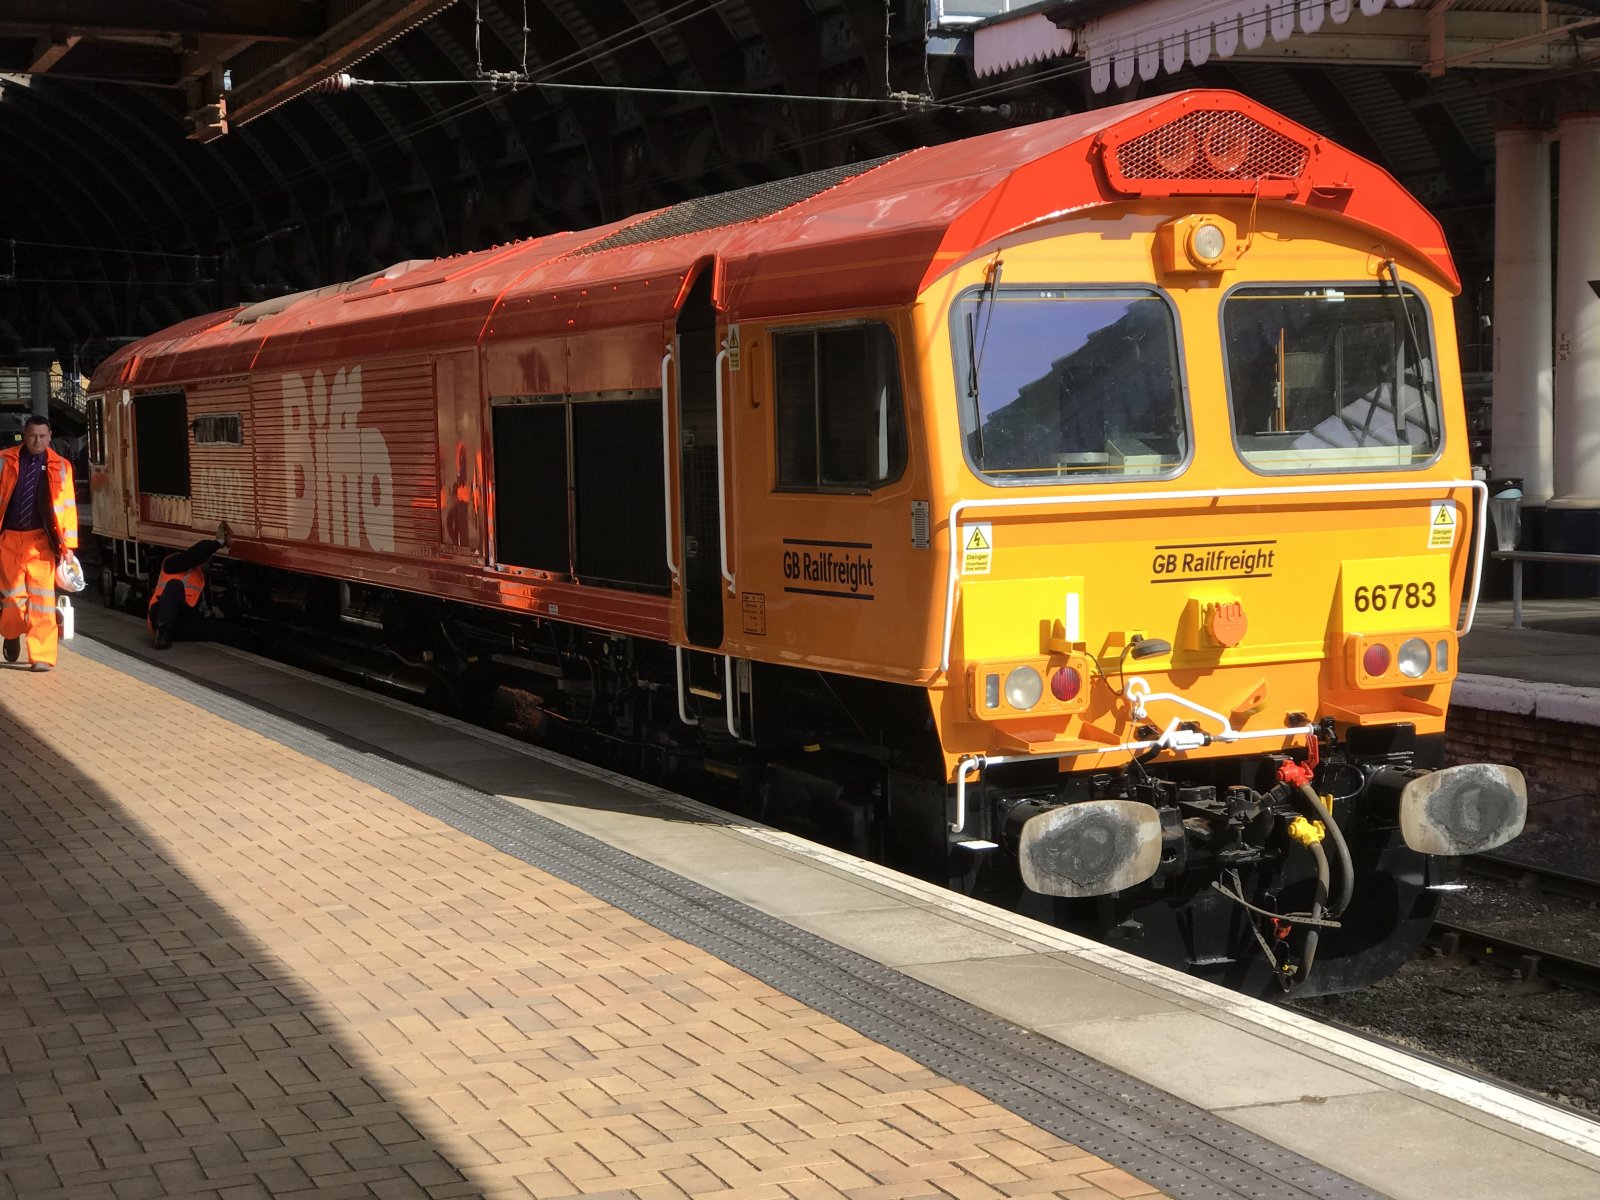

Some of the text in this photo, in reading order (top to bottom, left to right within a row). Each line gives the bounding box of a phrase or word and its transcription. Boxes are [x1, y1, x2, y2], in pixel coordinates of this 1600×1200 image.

[783, 551, 874, 592] GB Railfreight
[1152, 548, 1275, 574] GB Railfreight
[1354, 581, 1437, 613] 66783
